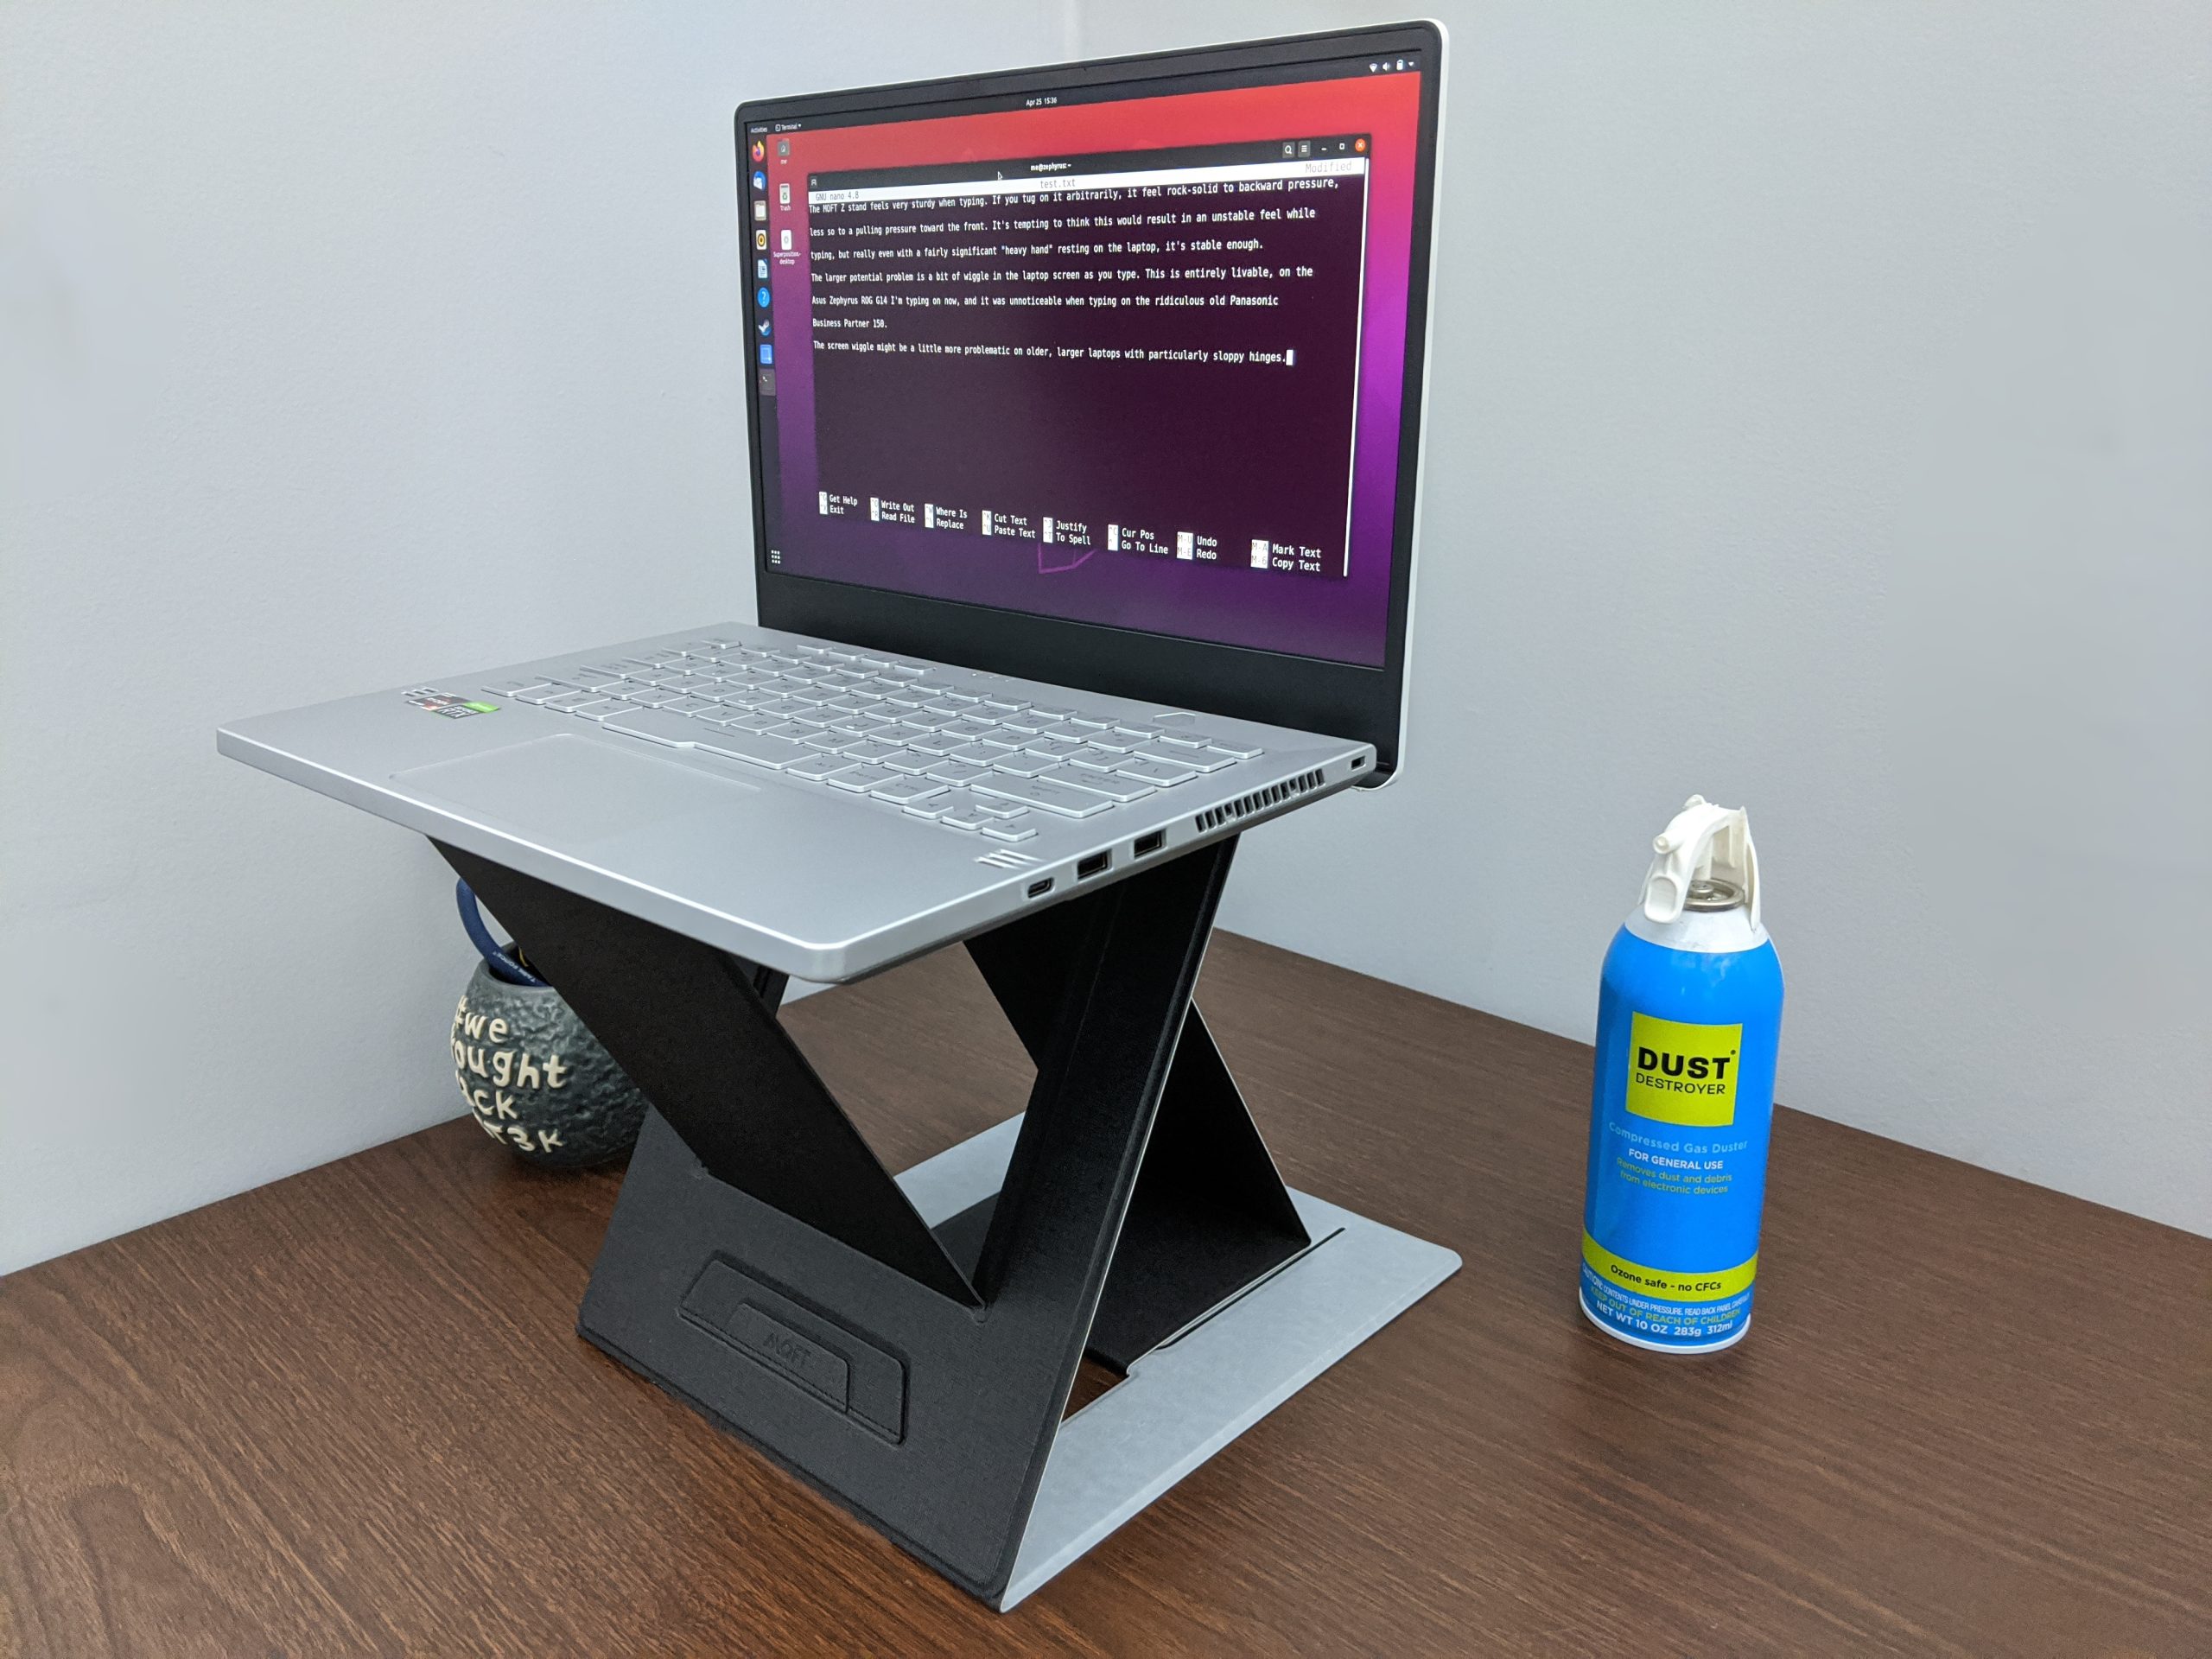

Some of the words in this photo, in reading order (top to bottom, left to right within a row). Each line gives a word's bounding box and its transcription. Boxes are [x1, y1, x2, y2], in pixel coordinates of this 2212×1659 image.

[1026, 99, 1035, 107] Apr
[1306, 160, 1351, 173] Modified
[1040, 179, 1076, 188] test.txt
[810, 204, 820, 213] The
[823, 203, 837, 213] MOFT
[841, 203, 845, 212] Z
[849, 201, 867, 211] stand
[870, 200, 889, 210] feels
[893, 201, 908, 211] very
[912, 198, 936, 210] sturdy
[939, 197, 956, 207] when
[959, 195, 988, 208] typing.
[993, 194, 1001, 204] If
[1005, 196, 1018, 206] you
[1022, 193, 1035, 205] tug
[1053, 191, 1062, 201] it
[1066, 188, 1122, 203] arbitrarily,
[1128, 188, 1137, 198] it
[1141, 186, 1161, 197] feel
[1166, 183, 1217, 195] rock-solid
[1223, 182, 1233, 193] to
[1238, 180, 1282, 192] backward
[1287, 179, 1338, 193] pressure,
[816, 192, 827, 200] GNU
[830, 296, 858, 307] Zephyrus
[861, 296, 873, 304] ROG
[876, 296, 887, 304] G14
[891, 296, 902, 304] I'm
[906, 296, 929, 307] typing
[964, 296, 976, 305] and
[981, 296, 988, 305] it
[1009, 296, 1062, 305] unnoticeable
[1066, 296, 1084, 305] when
[1089, 296, 1116, 308] typing
[1135, 296, 1149, 305] the
[1154, 296, 1205, 305] ridiculous
[1209, 296, 1224, 305] old
[1230, 296, 1278, 306] Panasonic
[813, 319, 841, 327] Business
[844, 319, 869, 327] Partner
[873, 319, 887, 327] 150.
[852, 342, 874, 353] wiggle
[877, 342, 895, 353] might
[899, 343, 906, 352] be
[918, 343, 941, 353] little
[964, 345, 1010, 357] problematic
[1027, 346, 1052, 357] older,
[1057, 346, 1084, 359] larger
[1088, 347, 1120, 359] laptops
[1125, 348, 1144, 358] with
[1148, 348, 1208, 362] particularly
[1213, 350, 1243, 363] sloppy
[1249, 351, 1287, 365] hinges.
[830, 494, 840, 504] Get
[843, 496, 857, 506] Help
[881, 500, 899, 512] Write
[903, 503, 914, 512] Out
[830, 505, 844, 515] Exit
[937, 507, 956, 518] Where
[958, 508, 967, 518] Is
[882, 512, 897, 521] Read
[900, 513, 915, 524] File
[937, 518, 963, 530] Replace
[995, 513, 1007, 524] Cut
[1010, 515, 1027, 525] Text
[995, 526, 1014, 537] Paste
[1019, 528, 1035, 538] Text
[1056, 520, 1087, 534] Justify
[1056, 533, 1065, 543] To
[1069, 534, 1090, 546] Spell
[1122, 528, 1137, 538] Cur
[1141, 530, 1154, 540] Pos
[1122, 540, 1132, 550] Go
[1136, 542, 1145, 551] To
[1149, 543, 1168, 554] Line
[1197, 536, 1217, 547] Undo
[1197, 550, 1217, 560] Redo
[1273, 543, 1294, 556] Mark
[1300, 546, 1321, 558] Text
[1272, 557, 1294, 570] Copy
[1298, 560, 1320, 572] Text
[451, 1024, 567, 1089] ought
[1638, 1047, 1730, 1079] DUST
[1636, 1072, 1725, 1094] DESTROYER
[1609, 1122, 1680, 1152] Compressed
[1684, 1143, 1707, 1154] Gas
[1712, 1141, 1748, 1154] Duster
[1629, 1148, 1649, 1162] FOR
[1651, 1156, 1700, 1170] GENERAL
[1704, 1160, 1724, 1170] USE
[1617, 1157, 1656, 1178] Removes
[1659, 1171, 1680, 1181] dust
[1683, 1174, 1701, 1183] and
[1704, 1173, 1732, 1184] debris
[1620, 1171, 1640, 1185] from
[1643, 1180, 1690, 1194] electronic
[1694, 1185, 1728, 1195] devices
[1611, 1265, 1642, 1283] Ozone
[1645, 1278, 1667, 1289] safe
[1695, 1281, 1721, 1292] CFCs
[1591, 1287, 1608, 1303] KEEP
[1610, 1299, 1626, 1313] OUT
[1630, 1307, 1643, 1318] OF
[1646, 1313, 1681, 1325] REACH
[1684, 1316, 1697, 1325] OF
[1700, 1309, 1741, 1325] CHILDREN
[1629, 1298, 1649, 1310] UNDER
[1701, 1306, 1717, 1315] BACK
[1597, 1300, 1612, 1317] NET
[1617, 1312, 1632, 1325] WT
[1636, 1319, 1648, 1330] 10
[1651, 1323, 1668, 1334] OZ
[1675, 1326, 1701, 1337] 283g
[1707, 1321, 1732, 1334] 312ml
